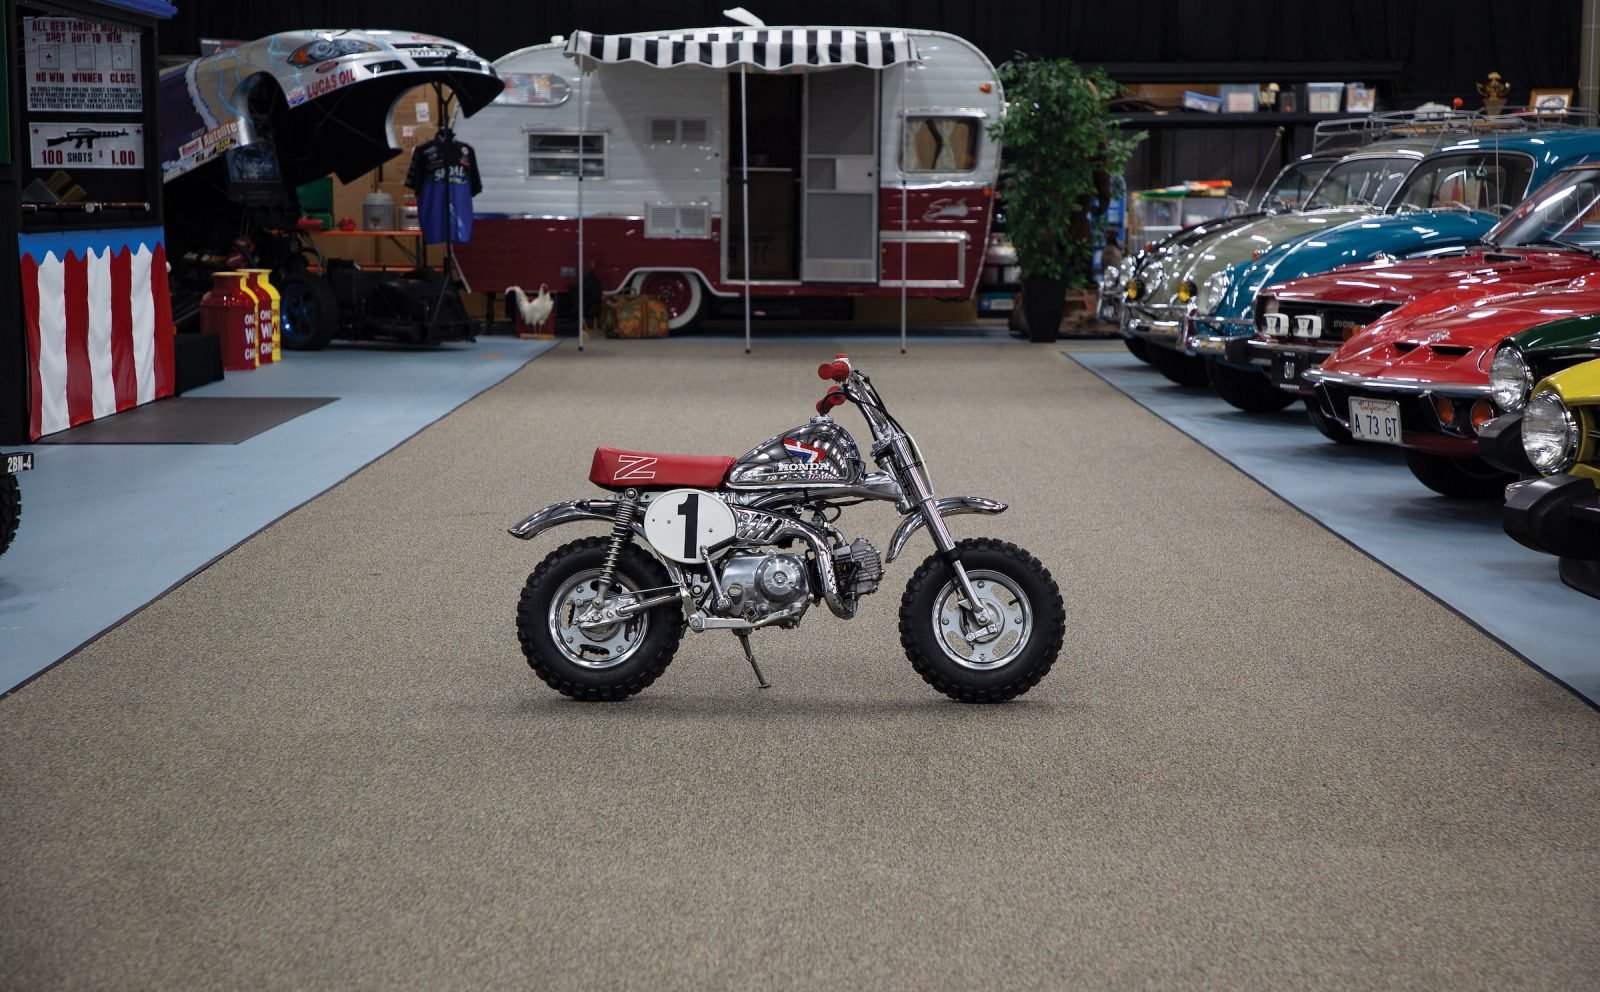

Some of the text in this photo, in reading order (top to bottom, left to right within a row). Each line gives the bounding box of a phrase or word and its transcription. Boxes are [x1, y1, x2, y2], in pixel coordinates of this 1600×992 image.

[32, 21, 47, 31] ALL
[46, 32, 122, 43] SHOT OUT TO WIN
[36, 72, 64, 82] NO WIN
[72, 72, 103, 83] WINNER
[110, 73, 136, 83] CLOSE
[306, 74, 337, 98] LUCAS
[339, 68, 356, 85] OIL
[42, 150, 63, 165] 100
[67, 152, 93, 162] SHOTS
[1355, 413, 1397, 438] A 73 GT
[613, 454, 657, 480] Z
[777, 462, 830, 472] HONDA
[677, 493, 699, 559] 1
